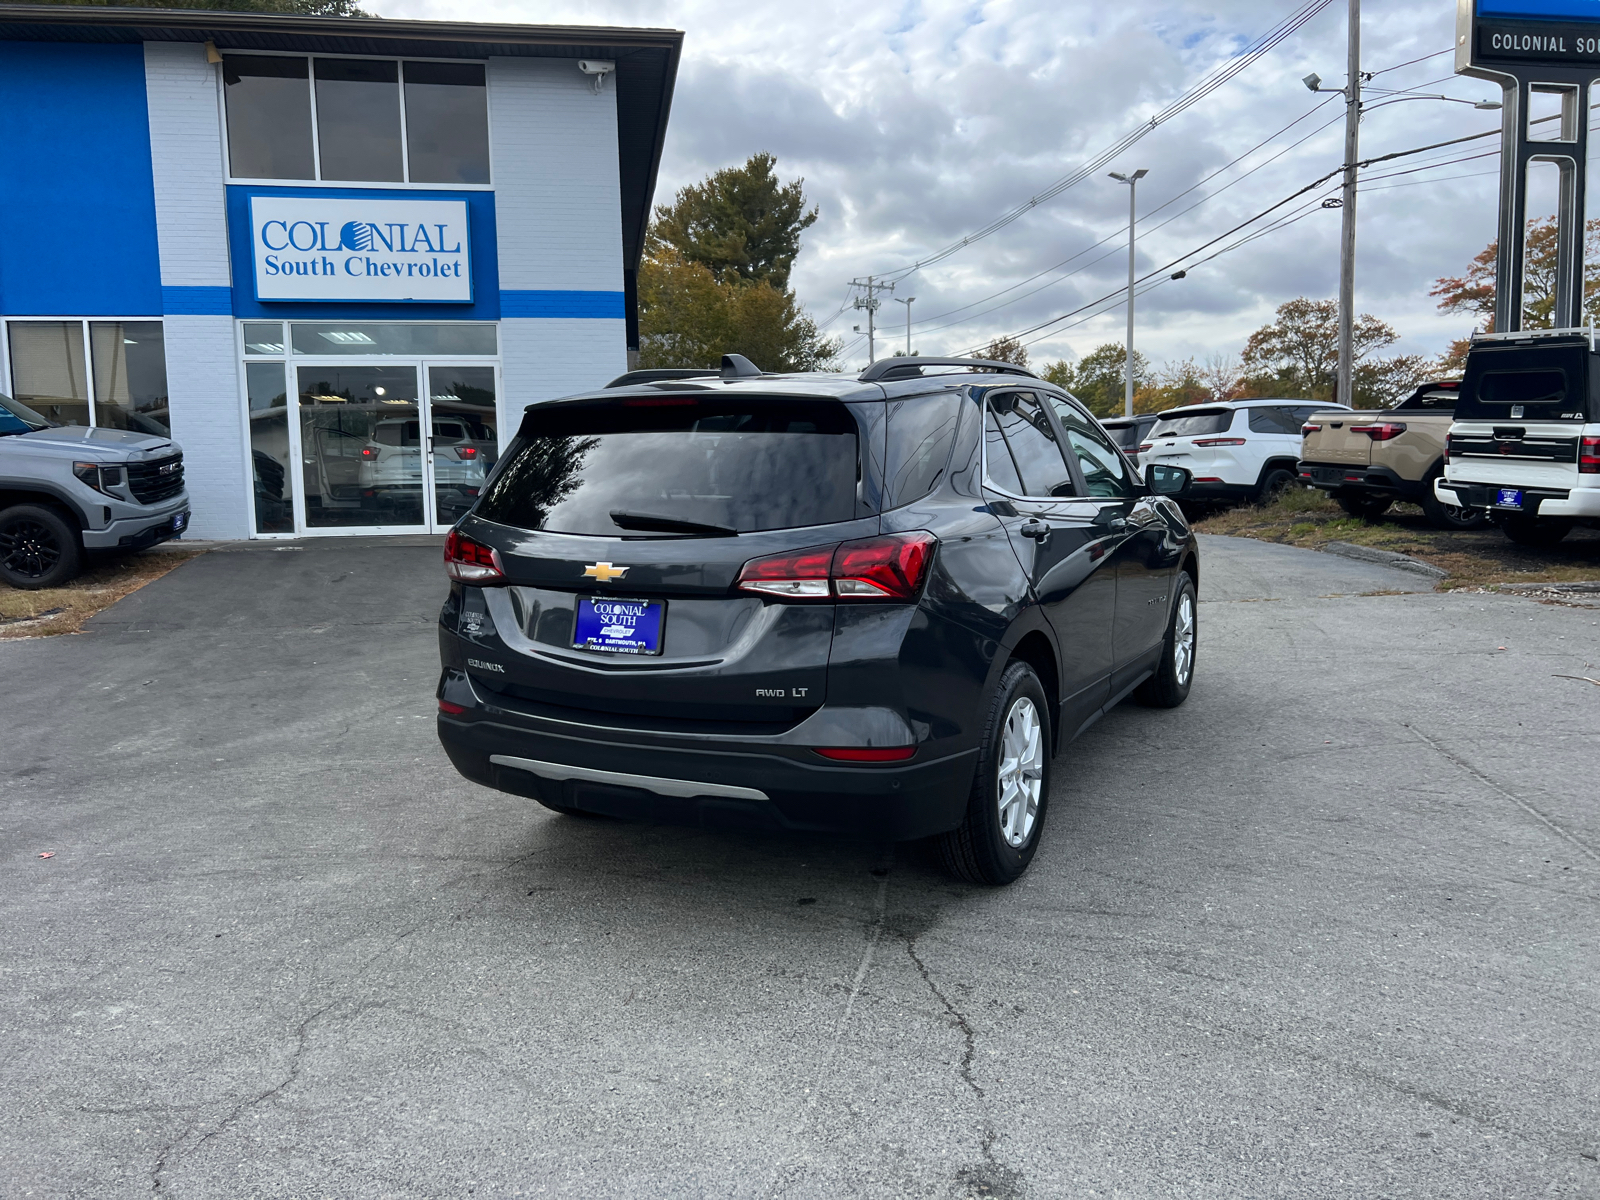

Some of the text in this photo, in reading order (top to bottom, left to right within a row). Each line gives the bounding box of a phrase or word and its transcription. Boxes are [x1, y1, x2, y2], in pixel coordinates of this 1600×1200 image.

[1492, 33, 1600, 53] COLONIAL SO
[261, 220, 461, 253] COLONIAL
[265, 255, 461, 278] South Chevrolet
[594, 603, 645, 616] COLONIAL
[600, 614, 636, 626] SOUTH
[468, 659, 504, 673] EQUINOX
[755, 688, 808, 697] AWD LT
